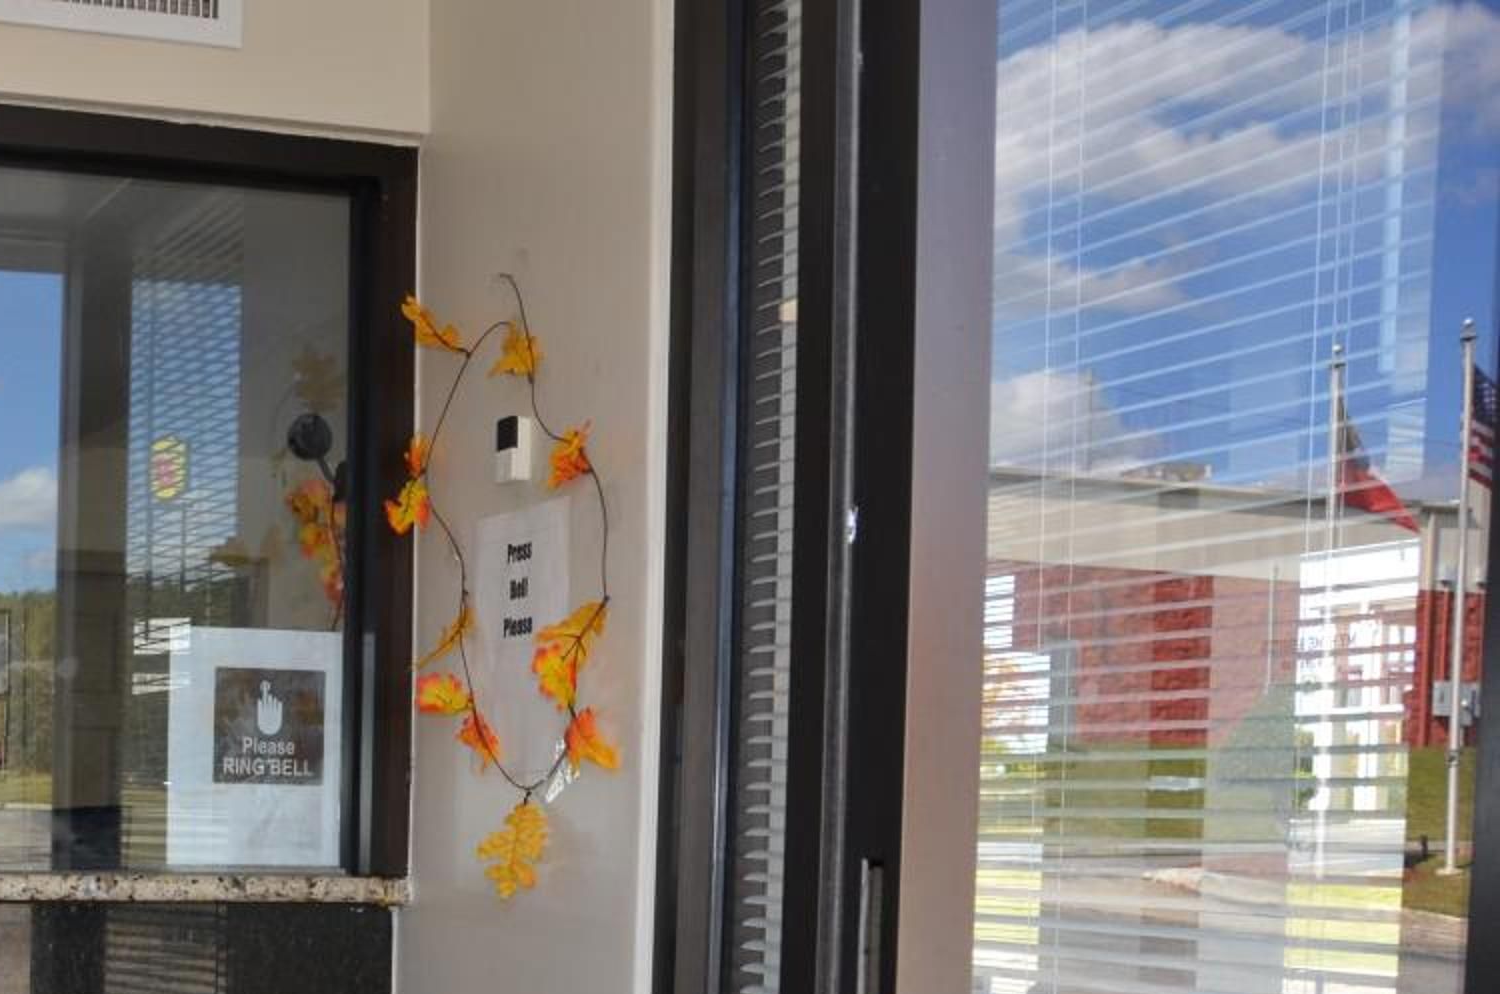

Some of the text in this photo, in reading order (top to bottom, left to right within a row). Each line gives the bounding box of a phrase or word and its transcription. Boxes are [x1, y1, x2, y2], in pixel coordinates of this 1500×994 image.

[507, 542, 533, 564] Press
[509, 577, 529, 600] Bell
[503, 616, 533, 639] Please
[241, 736, 296, 755] Please
[222, 757, 313, 776] RING BELL
